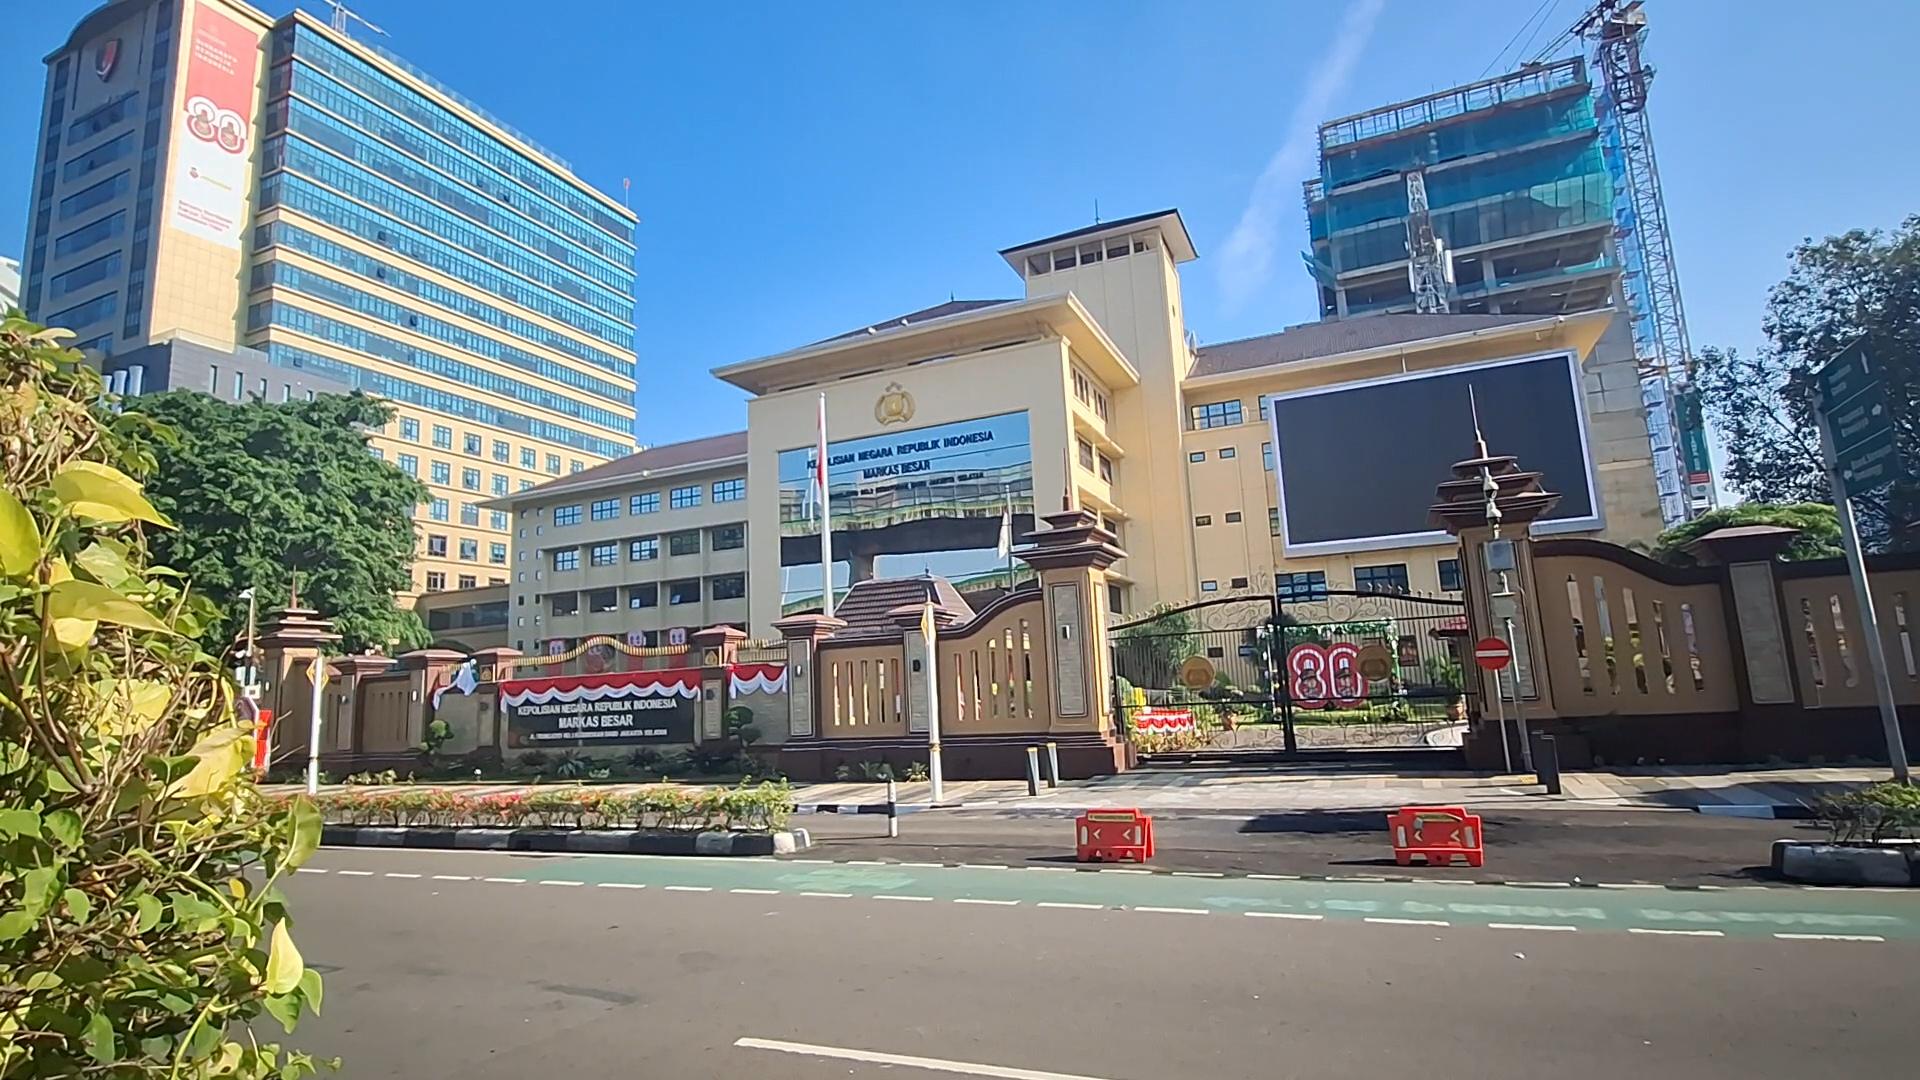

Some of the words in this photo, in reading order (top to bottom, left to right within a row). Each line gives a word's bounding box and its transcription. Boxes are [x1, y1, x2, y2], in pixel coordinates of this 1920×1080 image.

[807, 453, 855, 469] KELISIAN
[858, 446, 893, 461] NEGARA
[897, 439, 940, 455] REPUBLIK
[944, 430, 994, 448] INDONESIA
[863, 464, 899, 479] MARKAS
[901, 460, 931, 473] BESAR
[518, 704, 560, 716] KEPOLISIAN
[561, 702, 593, 714] NEGARA
[595, 700, 632, 712] REPUBLIK
[633, 698, 678, 710] INDONESIA
[558, 716, 599, 729] MARKAS
[601, 714, 633, 727] BESAR
